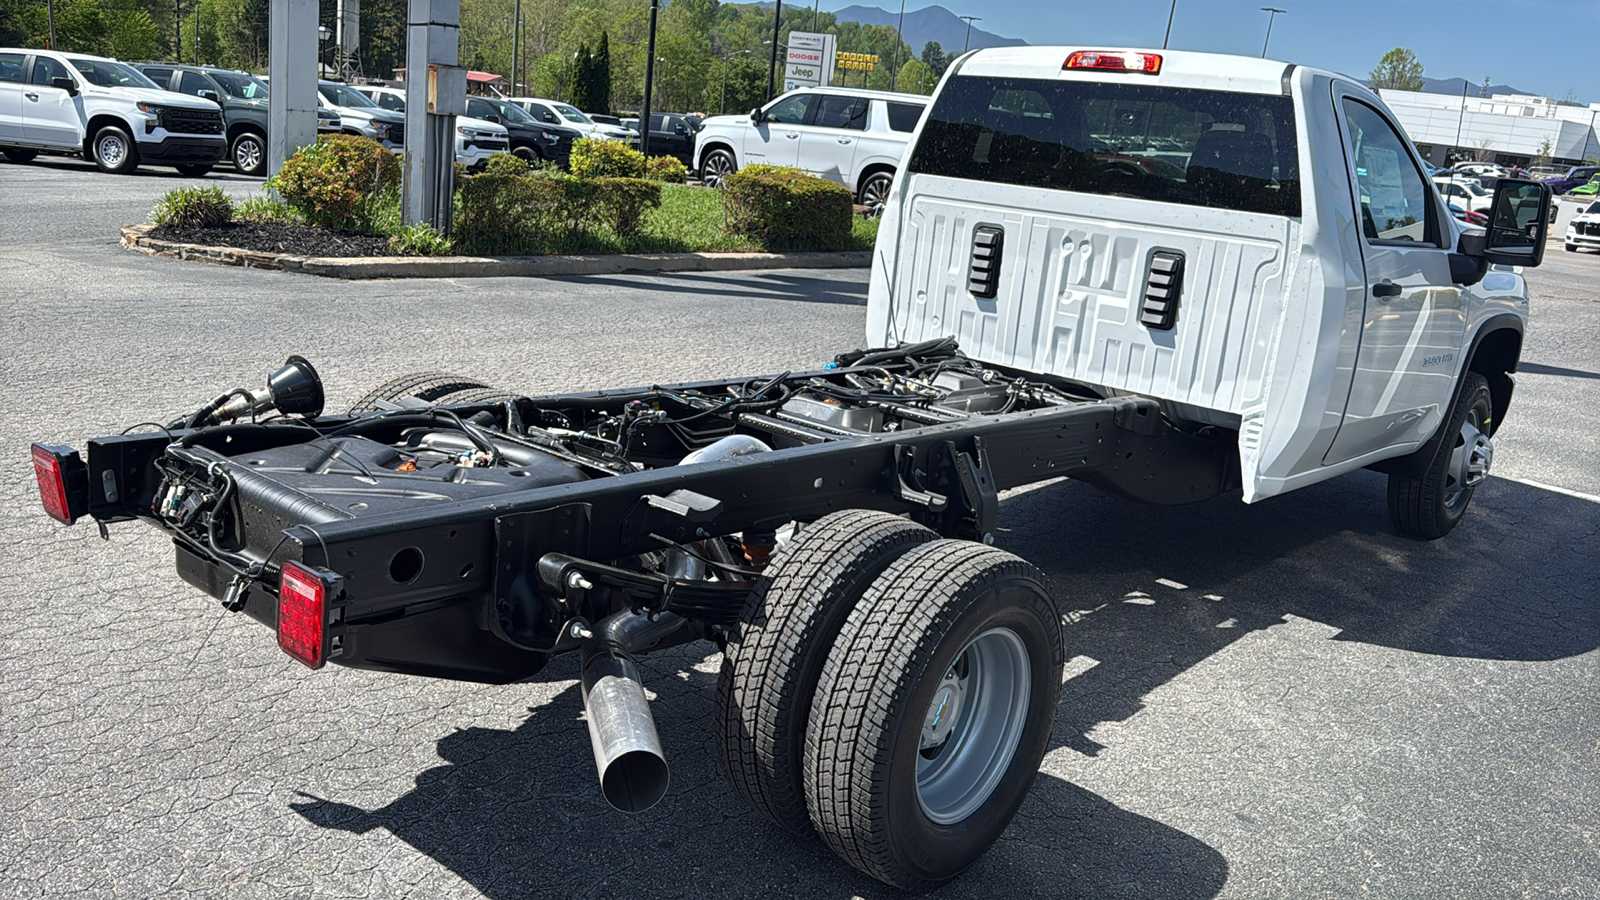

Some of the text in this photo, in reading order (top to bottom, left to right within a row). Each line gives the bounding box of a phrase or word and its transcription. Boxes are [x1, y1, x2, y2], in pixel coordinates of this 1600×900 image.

[789, 52, 820, 61] DODGE
[838, 60, 874, 71] HOUSE
[792, 66, 813, 78] Jeep
